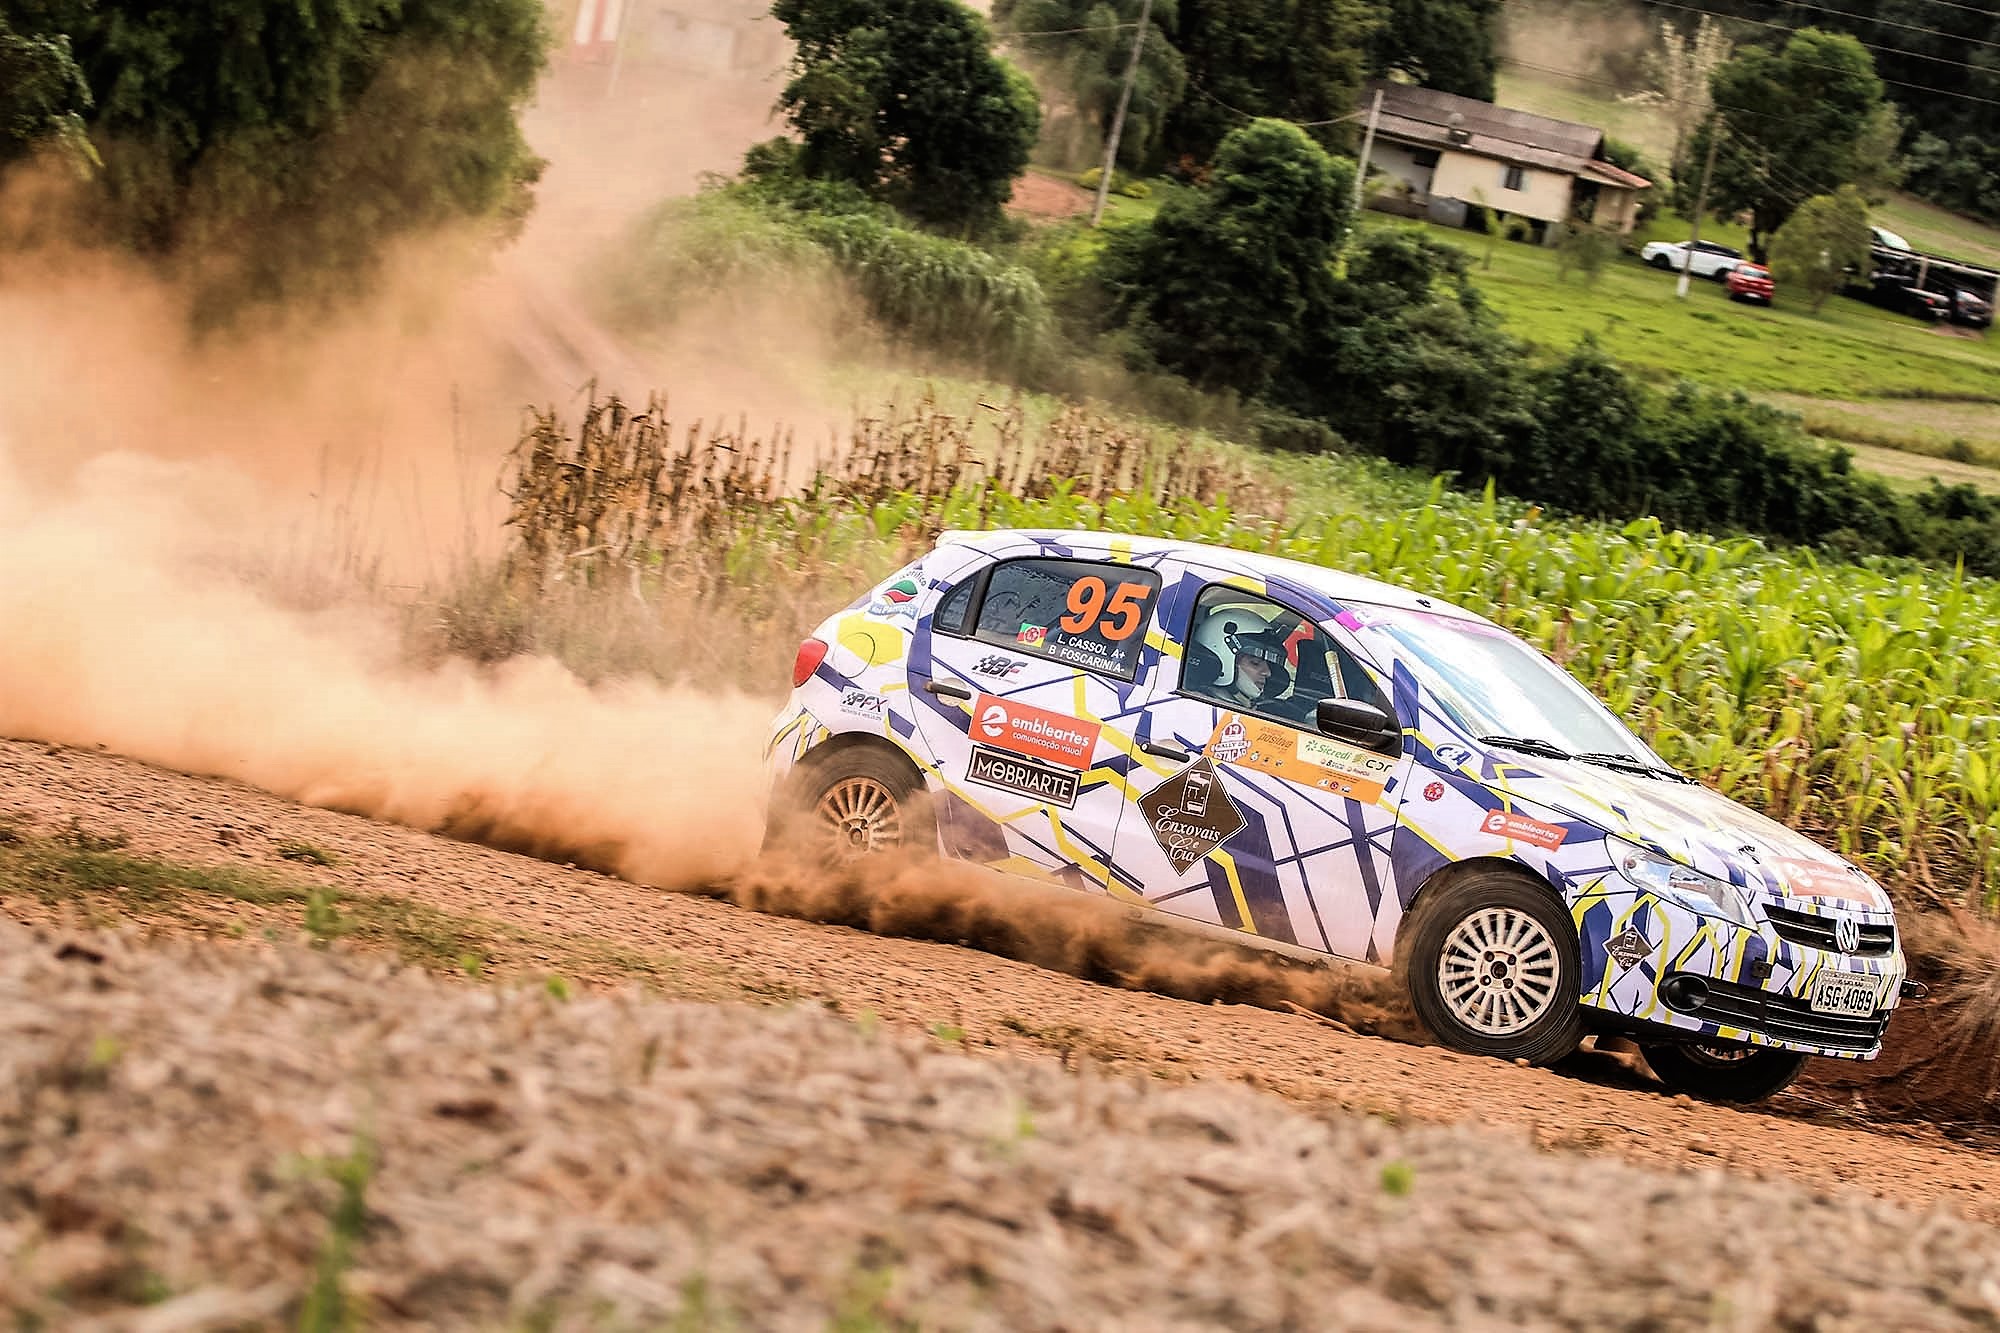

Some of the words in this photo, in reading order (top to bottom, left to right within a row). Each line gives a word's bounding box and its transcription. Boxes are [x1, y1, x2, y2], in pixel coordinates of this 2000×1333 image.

[1060, 576, 1152, 641] 95
[1060, 648, 1113, 671] FOSCARINI
[1112, 662, 1125, 672] A-
[1068, 636, 1108, 656] CASSOL
[1111, 648, 1126, 660] A+
[1011, 716, 1090, 747] embleartes
[1228, 724, 1240, 736] 19
[1012, 732, 1060, 750] comunicação
[1061, 744, 1083, 757] visual
[1316, 744, 1353, 761] Sicredi
[976, 756, 1072, 799] MOBRIARTE
[1156, 804, 1221, 842] Enxovais
[1168, 834, 1197, 862] Cia
[1192, 840, 1199, 849] e
